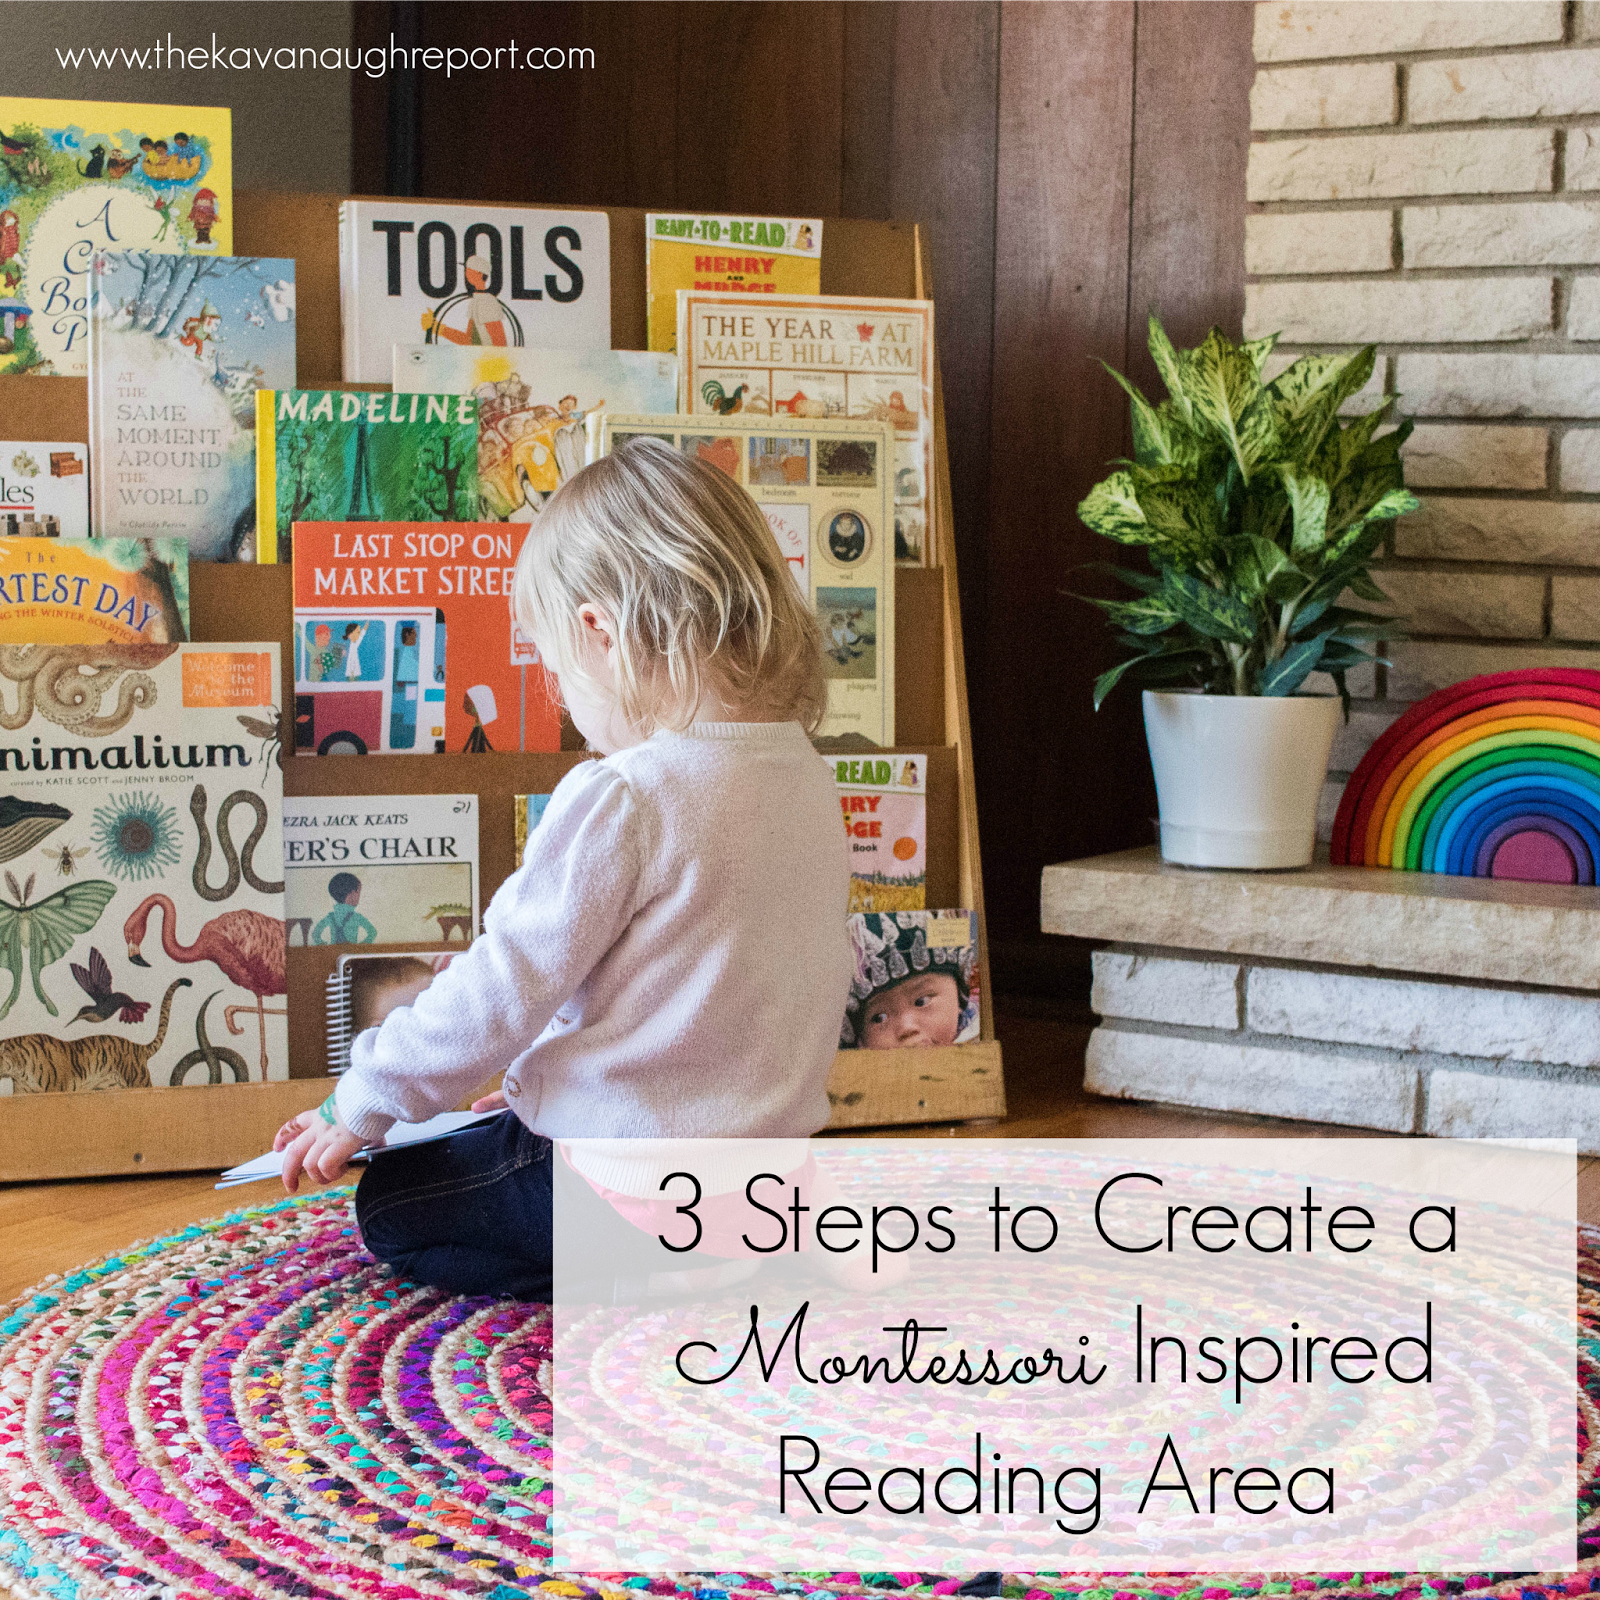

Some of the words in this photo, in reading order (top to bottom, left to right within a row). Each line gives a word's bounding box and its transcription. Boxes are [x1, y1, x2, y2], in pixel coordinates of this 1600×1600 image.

[76, 198, 119, 242] A
[372, 220, 584, 304] TOOLS
[695, 256, 777, 275] HENRY
[702, 315, 755, 338] THE
[766, 317, 834, 340] YEAR
[881, 323, 911, 343] AT
[702, 340, 783, 363] MAPLE
[792, 344, 844, 365] HILL
[849, 346, 913, 367] FARM
[118, 372, 135, 382] AT
[117, 387, 147, 398] THE
[117, 404, 187, 422] SAME
[278, 393, 476, 424] MADELINE
[117, 450, 222, 468] AROUND
[118, 473, 148, 483] THE
[119, 488, 209, 505] WORLD
[334, 533, 393, 558] LAST
[404, 533, 465, 558] STOP
[472, 533, 512, 559] ON
[27, 552, 55, 563] The
[314, 566, 428, 596] MARKET
[15, 608, 37, 618] THE
[41, 608, 85, 622] WINTER
[93, 583, 160, 632] DAY
[188, 659, 254, 672] Welcome
[210, 674, 225, 684] to
[231, 673, 254, 684] the
[189, 684, 254, 697] Museum
[46, 777, 73, 785] KATIE
[77, 776, 109, 785] SCOTT
[125, 775, 154, 785] JENNY
[836, 760, 891, 785] READ
[283, 815, 319, 828] EZRA
[323, 815, 359, 827] JACK
[363, 813, 409, 827] KEATS
[284, 837, 350, 862] ER'S
[359, 836, 458, 860] CHAIR
[853, 843, 878, 853] Book
